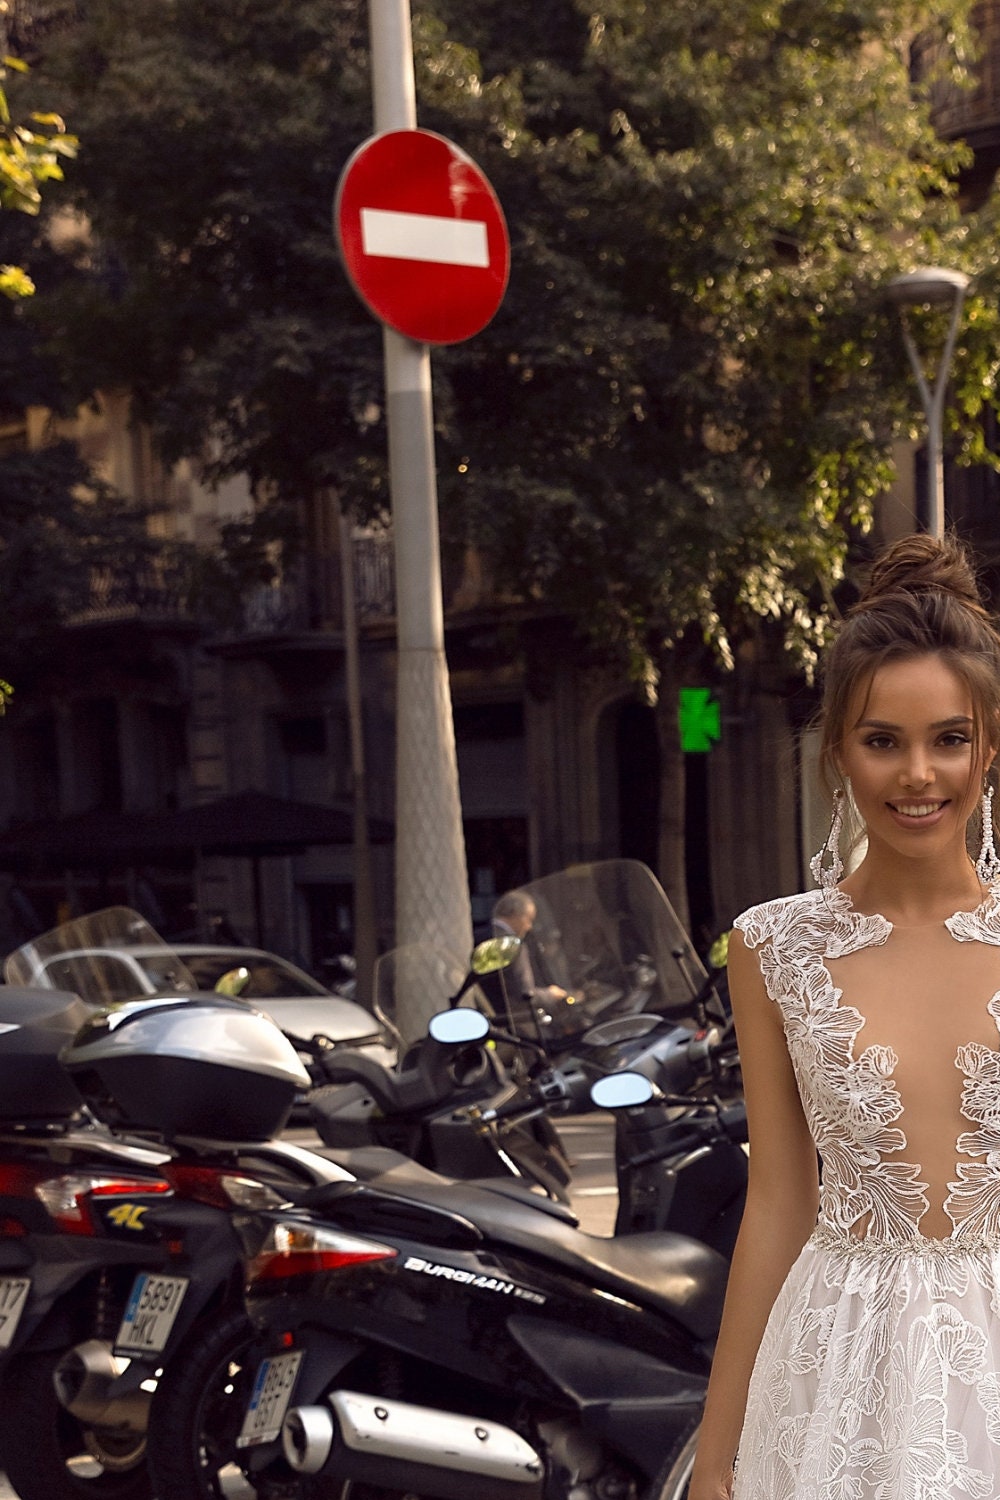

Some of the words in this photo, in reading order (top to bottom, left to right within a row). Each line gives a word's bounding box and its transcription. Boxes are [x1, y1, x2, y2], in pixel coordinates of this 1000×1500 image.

[404, 1256, 514, 1294] BURGMAN
[141, 1279, 183, 1314] 5891
[128, 1311, 159, 1346] HKL
